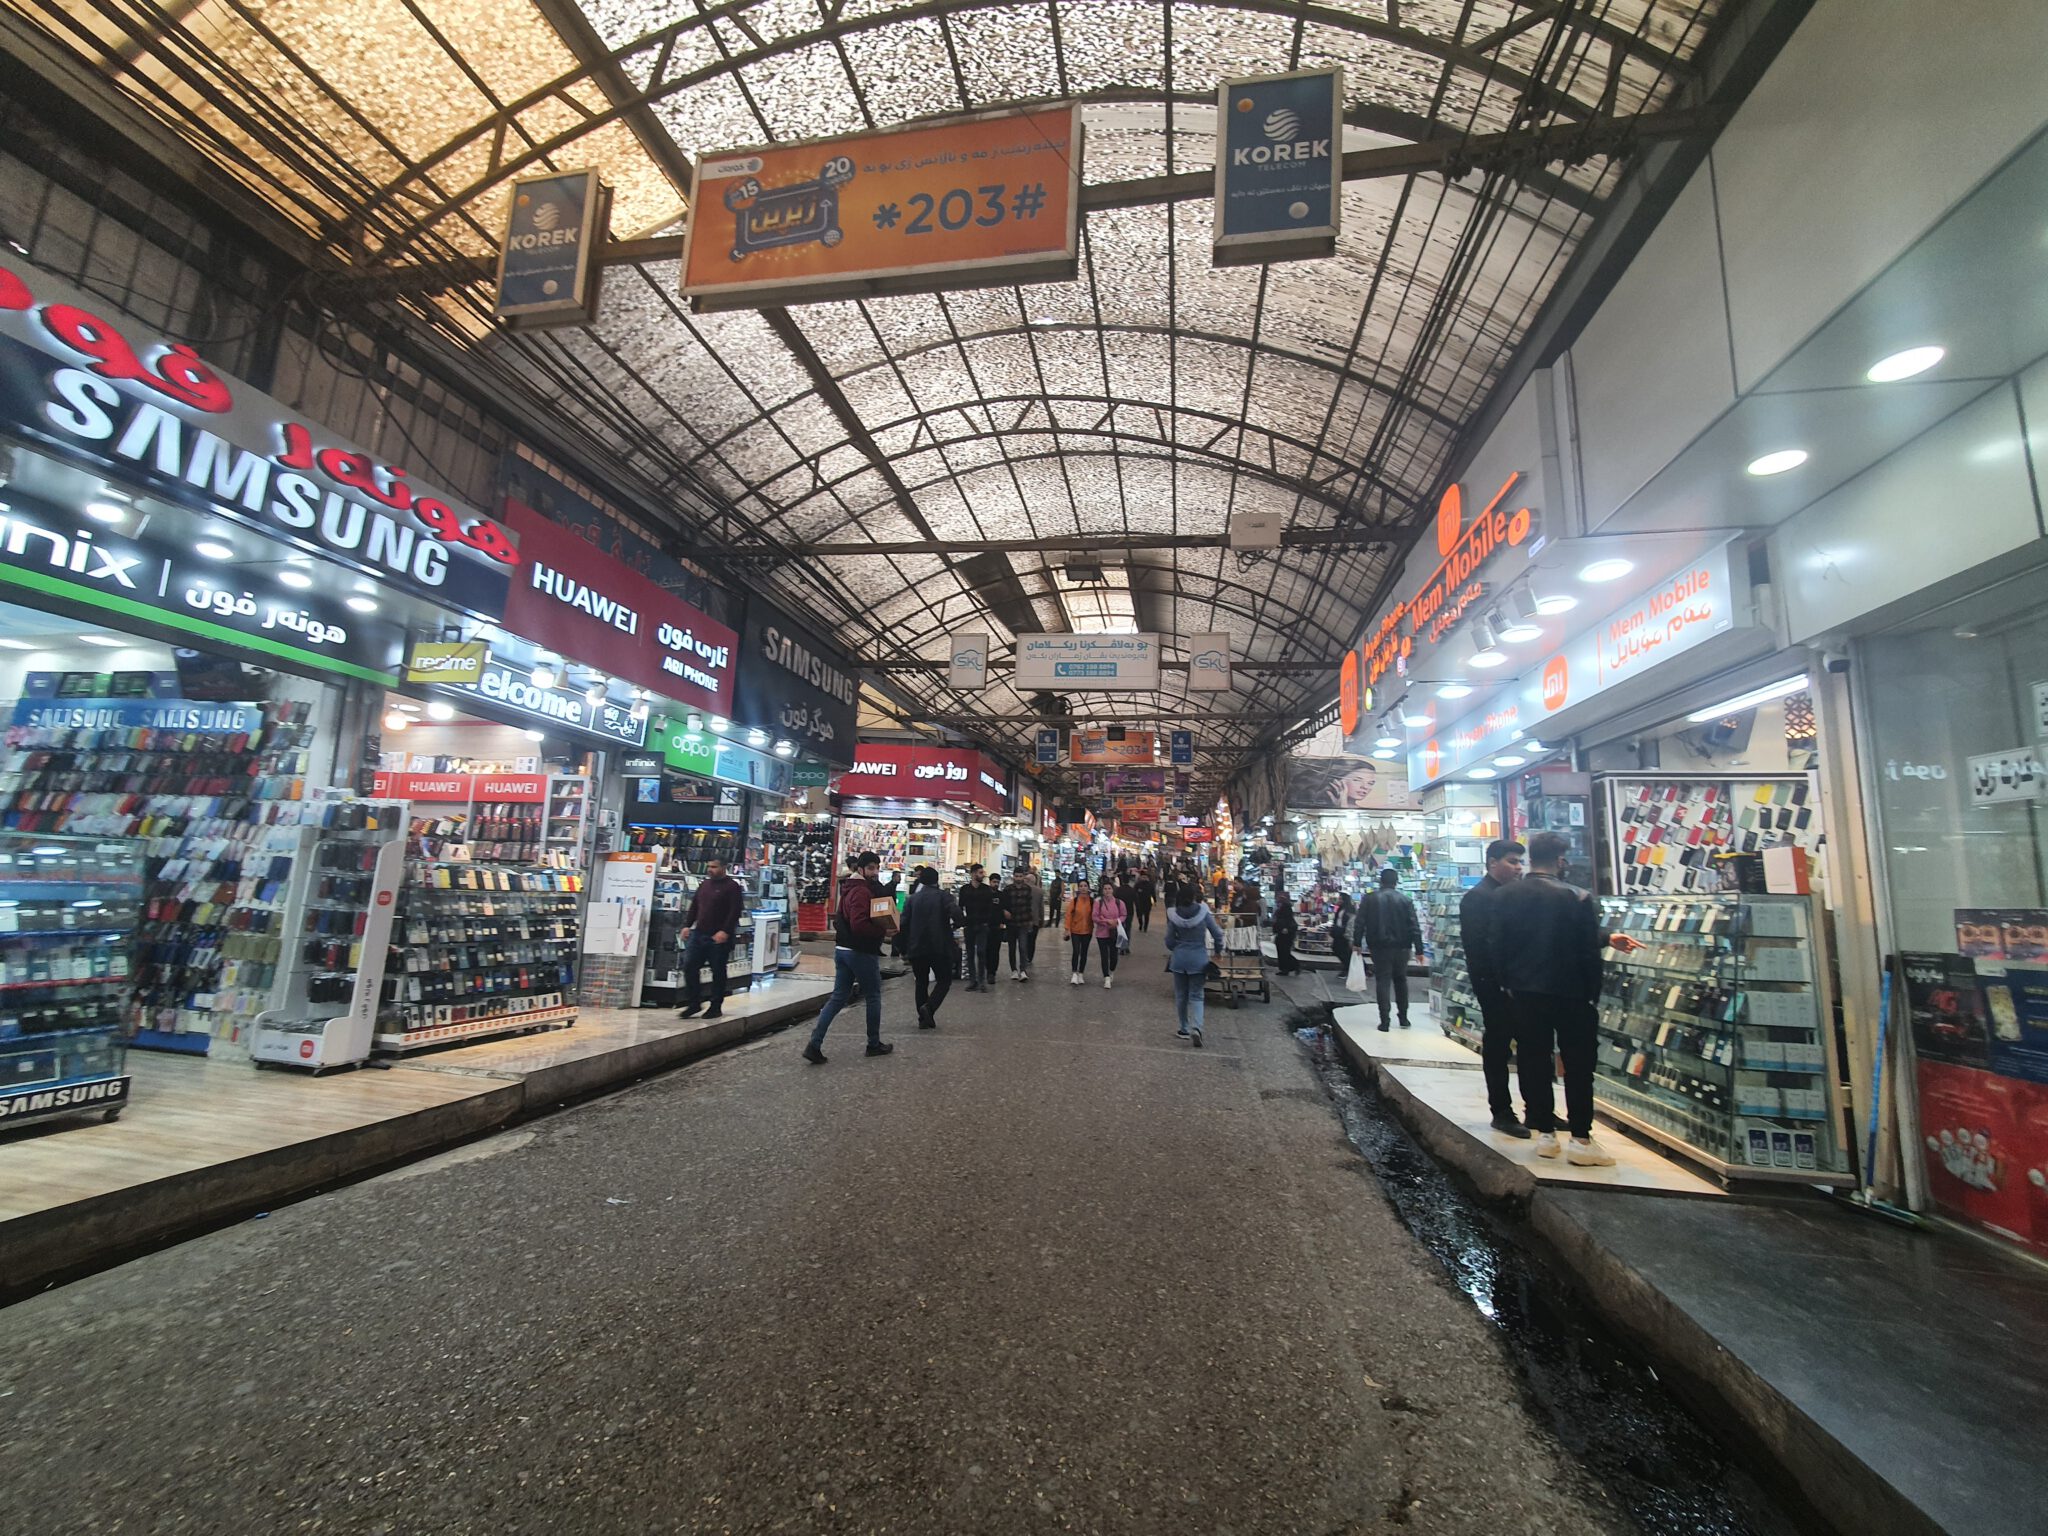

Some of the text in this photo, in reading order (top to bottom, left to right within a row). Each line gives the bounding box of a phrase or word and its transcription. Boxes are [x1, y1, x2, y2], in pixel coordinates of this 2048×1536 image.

[1234, 139, 1330, 166] KOREK
[825, 157, 850, 178] 20
[1258, 161, 1307, 171] TELECOM
[740, 180, 759, 198] 15
[509, 227, 579, 251] KOREK
[46, 368, 450, 587] SAMSUNG
[1411, 511, 1506, 635] Mem Mobile
[531, 561, 639, 636] HUAWEI
[1610, 569, 1711, 644] Mem Mobile
[415, 655, 477, 671] realme
[662, 656, 719, 693] ARI PHONE
[765, 626, 854, 706] SAMSUNG
[457, 668, 582, 722] elcome
[672, 736, 710, 759] oppo
[624, 758, 657, 768] infinix
[849, 762, 897, 776] UAWEI
[409, 781, 461, 793] HUAWEI
[484, 782, 537, 794] HUAWEI
[0, 1081, 122, 1117] SAMSUNG
